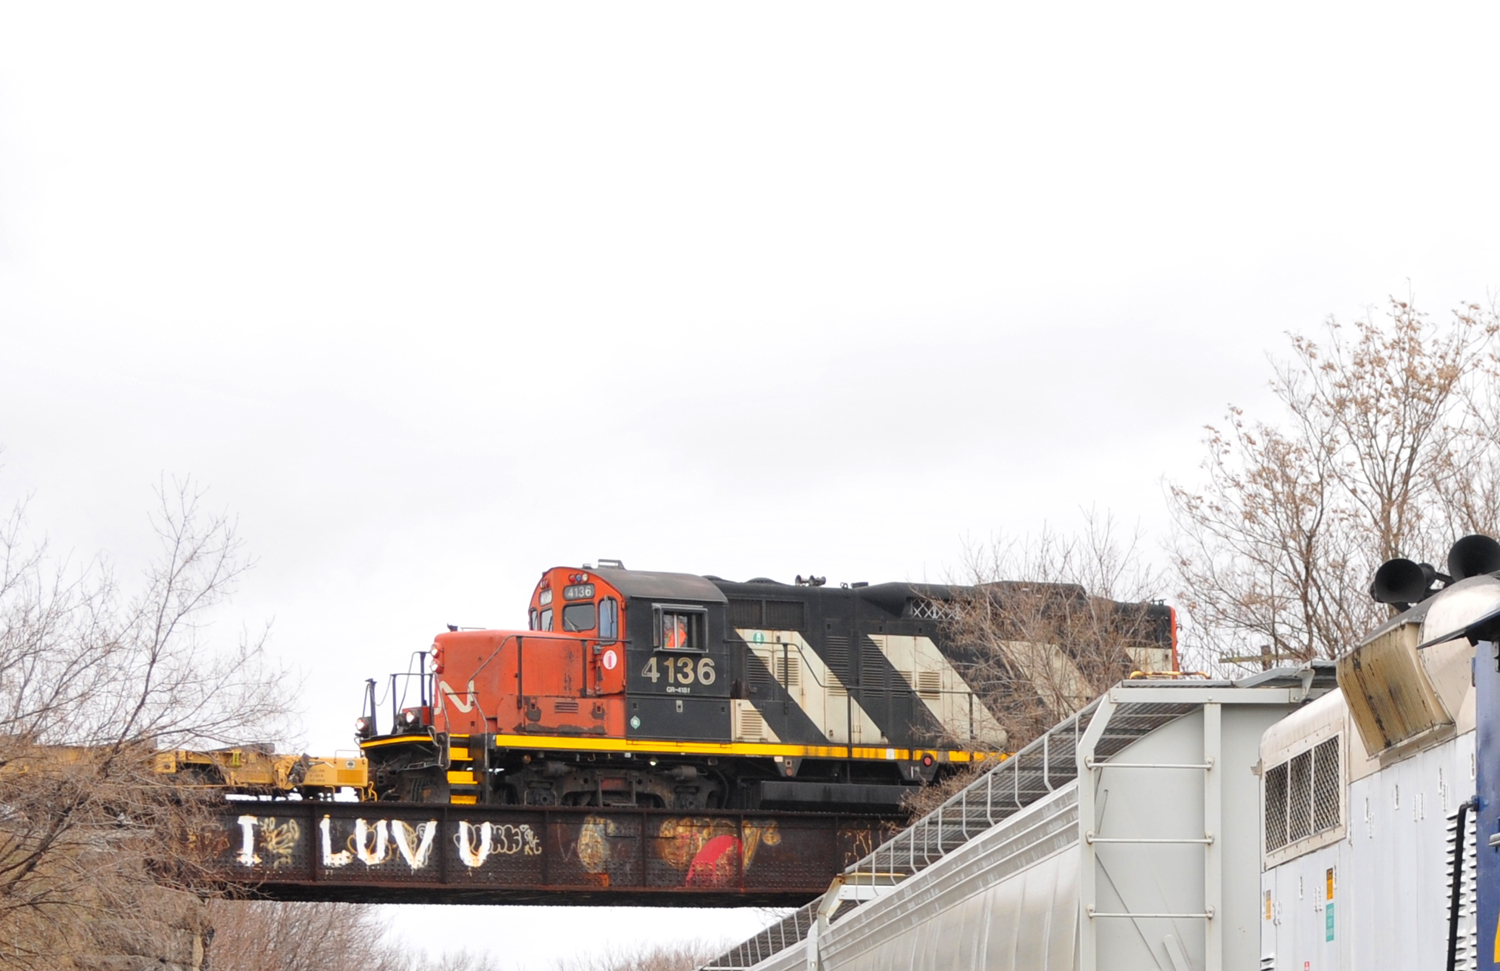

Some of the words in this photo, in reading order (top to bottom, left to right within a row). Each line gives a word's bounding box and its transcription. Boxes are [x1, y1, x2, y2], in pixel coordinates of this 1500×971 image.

[567, 587, 592, 598] 4136
[641, 657, 716, 685] 4136
[237, 814, 262, 867] I
[319, 814, 438, 869] LUV
[459, 820, 491, 868] U
